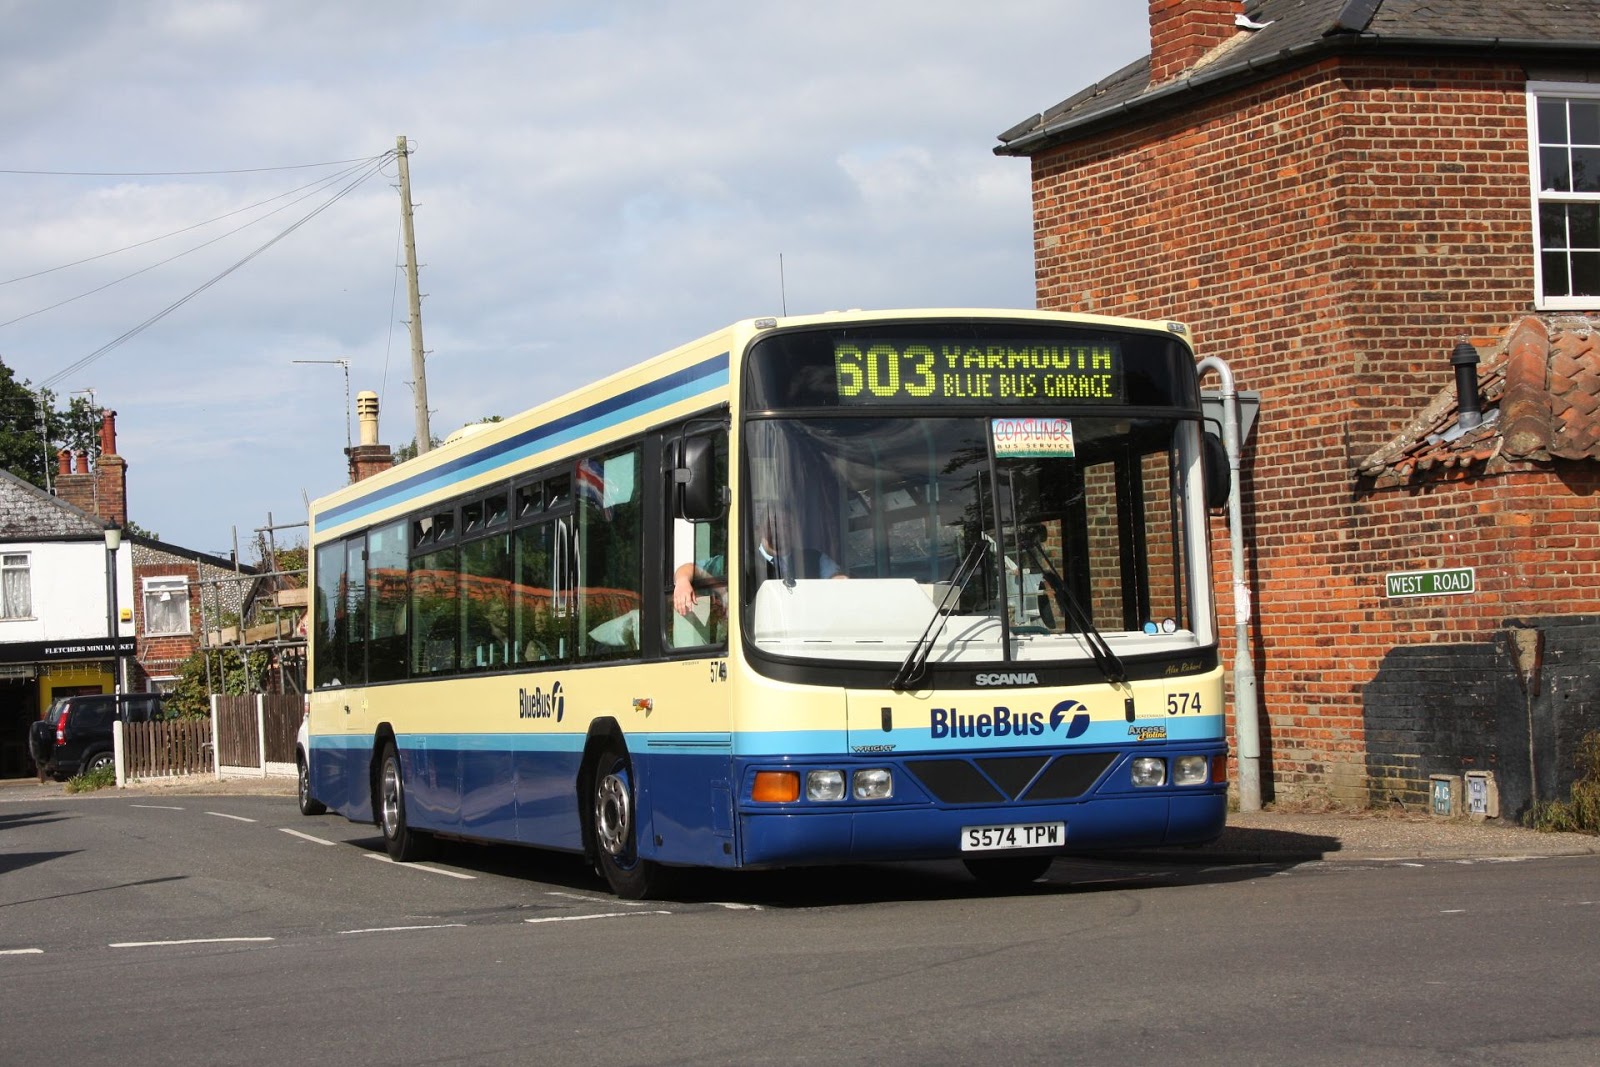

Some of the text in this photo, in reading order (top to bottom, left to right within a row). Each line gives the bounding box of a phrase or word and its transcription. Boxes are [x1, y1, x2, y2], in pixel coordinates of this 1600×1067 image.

[942, 346, 1111, 369] YARMOUTH
[835, 345, 936, 396] 603
[943, 374, 1113, 398] BLUE BUS GARAGE
[995, 418, 1070, 442] COASTLINER
[1389, 572, 1470, 594] WEST ROAD
[45, 645, 86, 654] FLETCHERS
[104, 643, 134, 651] MAKET
[975, 672, 1038, 686] SCANIA
[519, 686, 551, 719] BlueBus
[1167, 692, 1202, 715] 574
[930, 706, 1045, 739] BlueBus
[851, 744, 897, 753] WRIGHT
[969, 825, 1058, 847] S574 TPW
